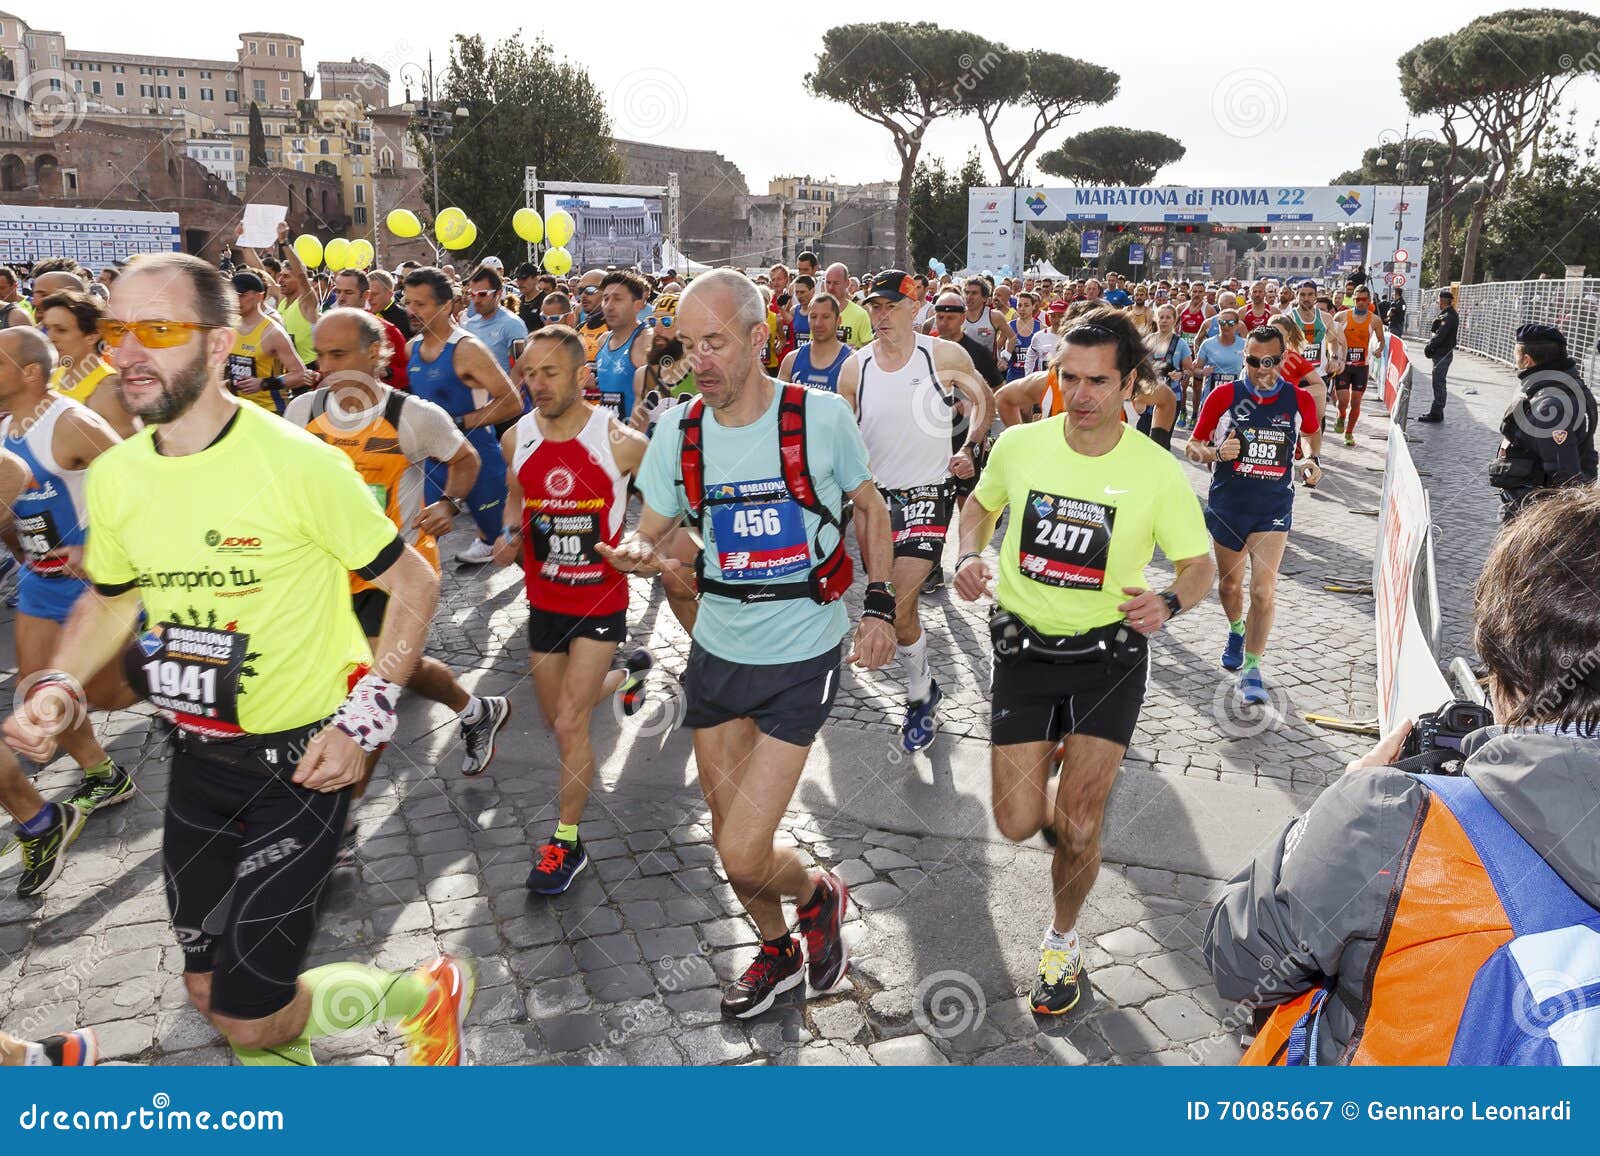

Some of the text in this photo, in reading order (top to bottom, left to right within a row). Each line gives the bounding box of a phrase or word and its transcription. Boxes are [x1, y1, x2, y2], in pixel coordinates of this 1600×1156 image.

[1075, 188, 1305, 206] MARATONA di ROMA 22
[1248, 442, 1277, 459] 893
[1242, 457, 1273, 466] FRANCESCO
[739, 480, 786, 493] MARATONA
[901, 500, 936, 522] 1322
[1057, 507, 1067, 517] di
[1058, 498, 1105, 515] MARATONA
[733, 508, 781, 537] 456
[549, 535, 581, 554] 910
[1034, 519, 1094, 555] 2477
[750, 553, 807, 569] new balance
[157, 565, 226, 592] proprio
[1045, 568, 1100, 584] new balance
[167, 627, 234, 647] MARATONA
[142, 659, 218, 704] 1941
